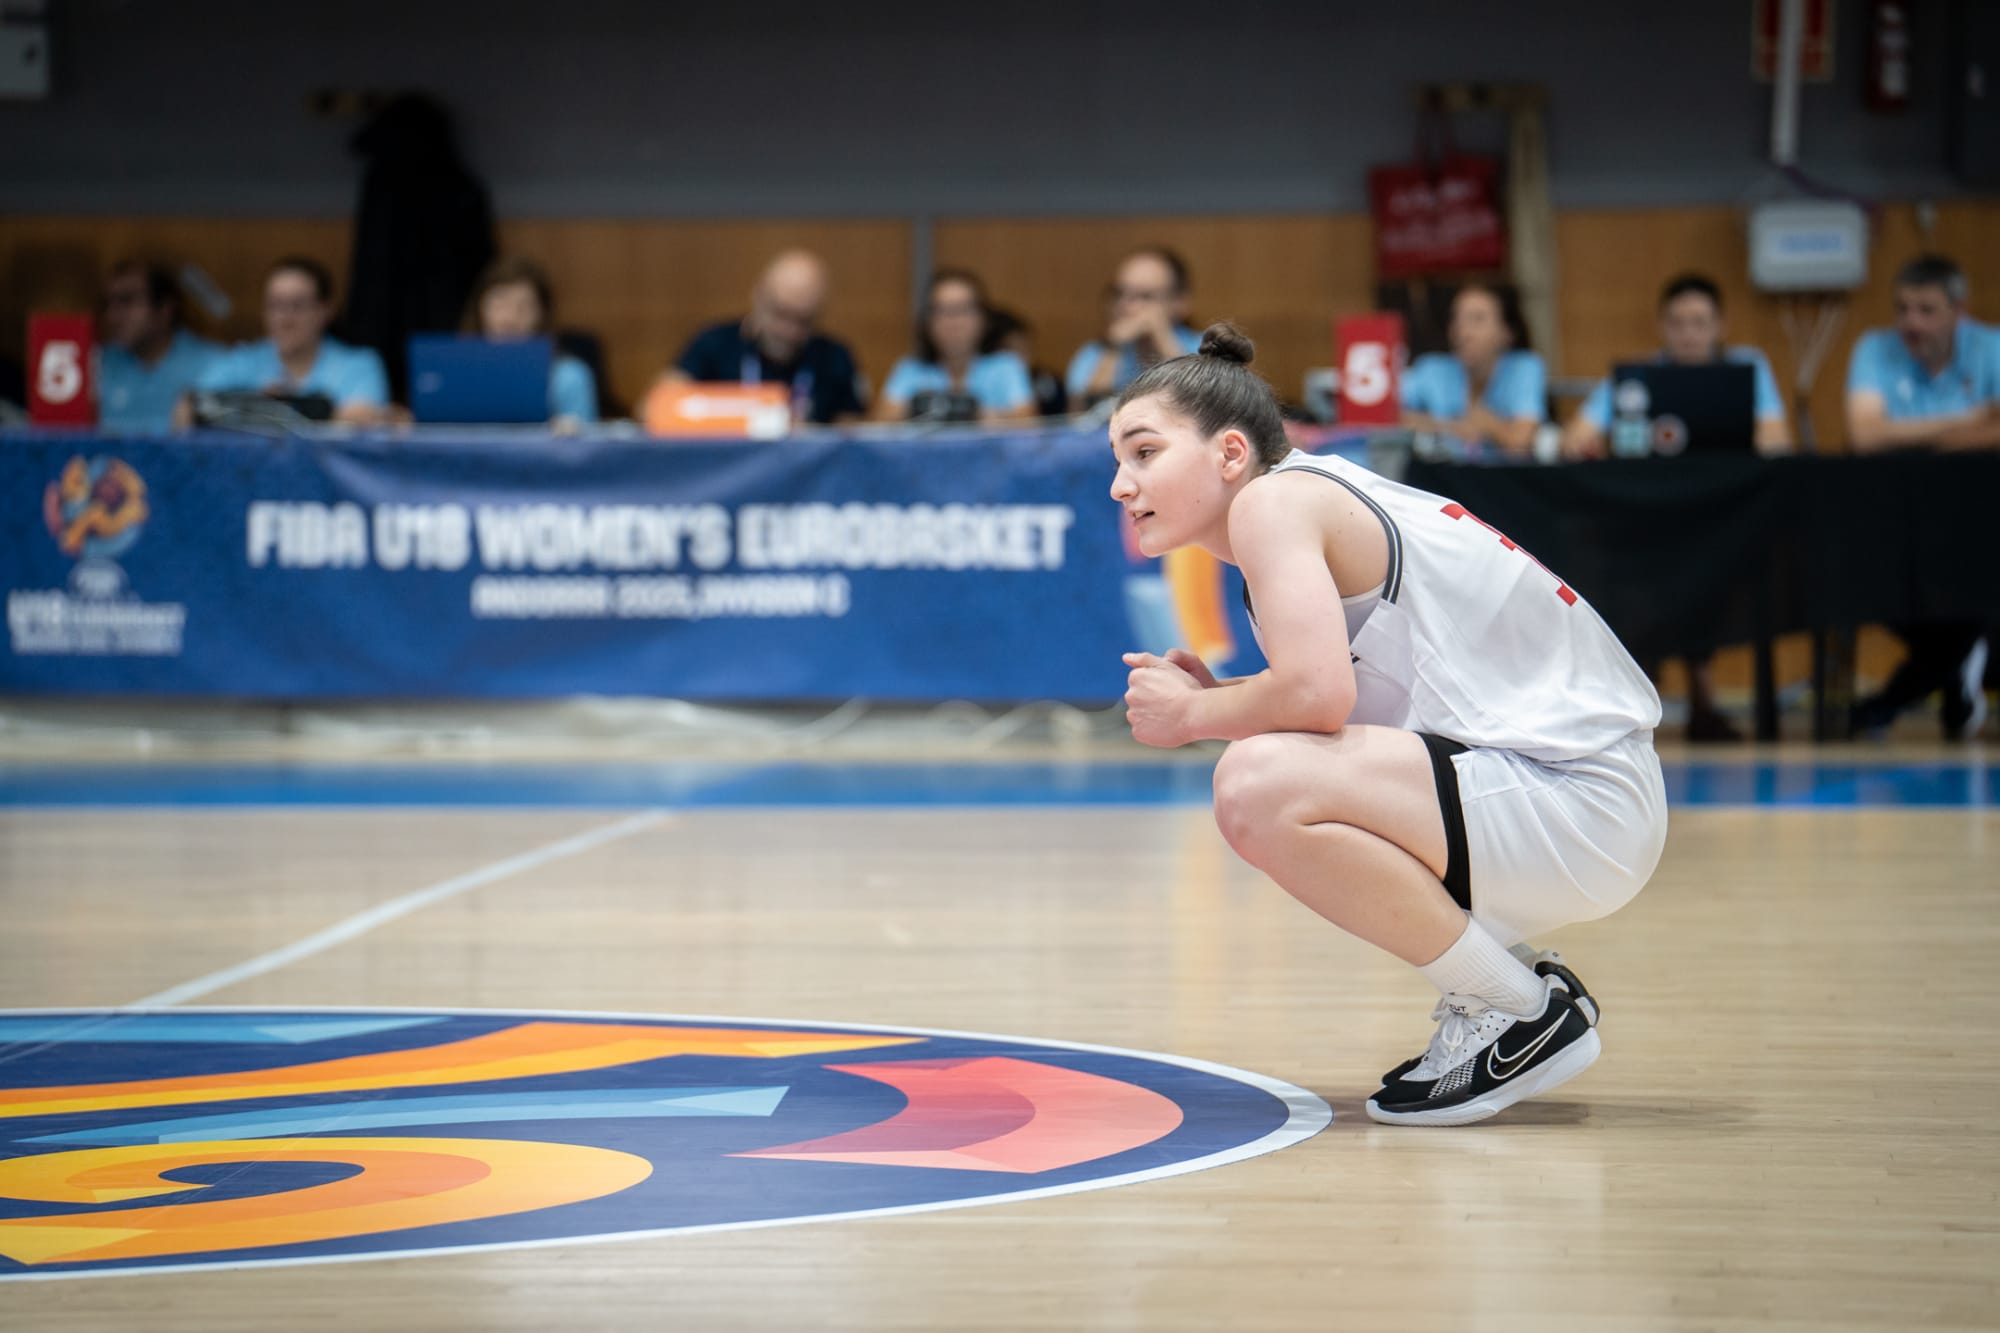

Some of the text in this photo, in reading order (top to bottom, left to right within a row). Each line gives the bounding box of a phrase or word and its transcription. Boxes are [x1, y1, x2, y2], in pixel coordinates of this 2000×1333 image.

[37, 339, 82, 404] 5
[1343, 341, 1390, 406] 5
[247, 501, 1072, 570] FIBA U18 WOMEN'S EUROBASKET
